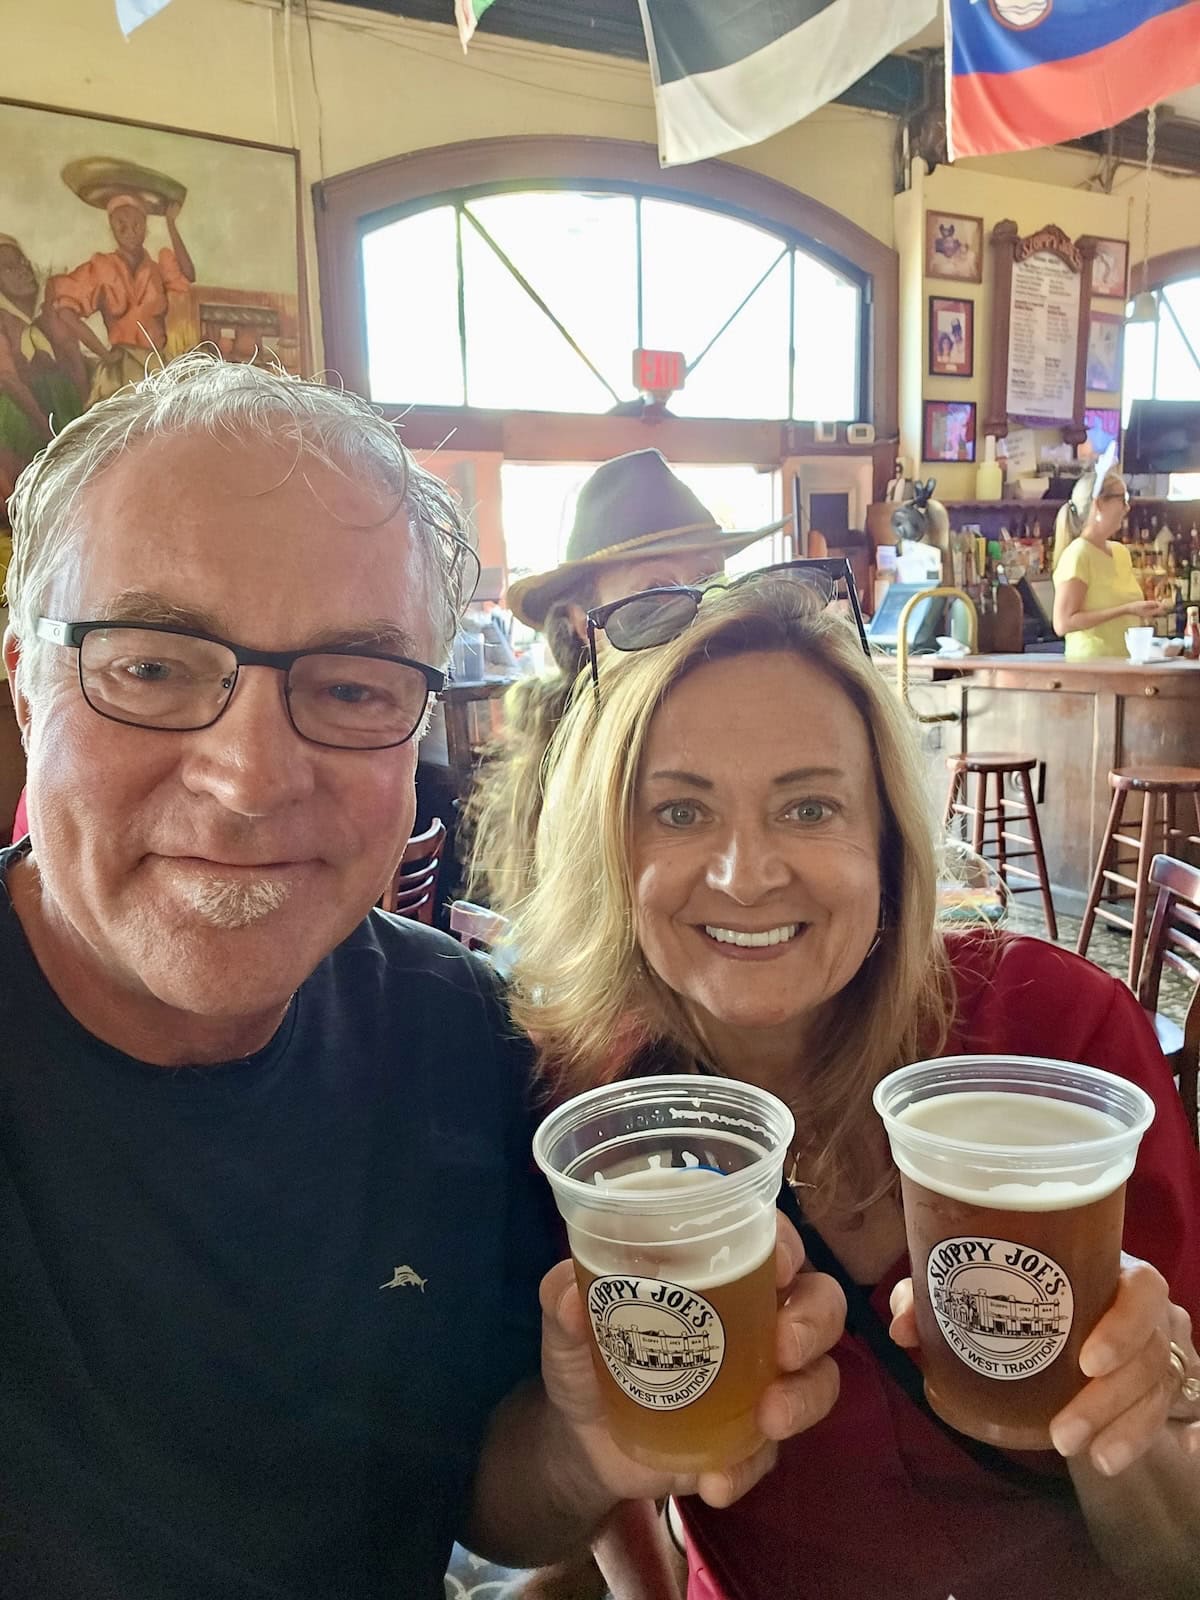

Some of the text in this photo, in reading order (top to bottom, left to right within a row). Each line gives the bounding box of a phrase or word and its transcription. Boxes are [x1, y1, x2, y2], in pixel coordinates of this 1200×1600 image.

[641, 351, 679, 388] EXIT
[930, 1241, 1067, 1296] SLOPPY JOE'S
[589, 1279, 714, 1328] SLOPPY JOE'S
[942, 1319, 1058, 1375] A KEY WEST TRADITION
[605, 1353, 710, 1405] A KEY WEST TRADITION
